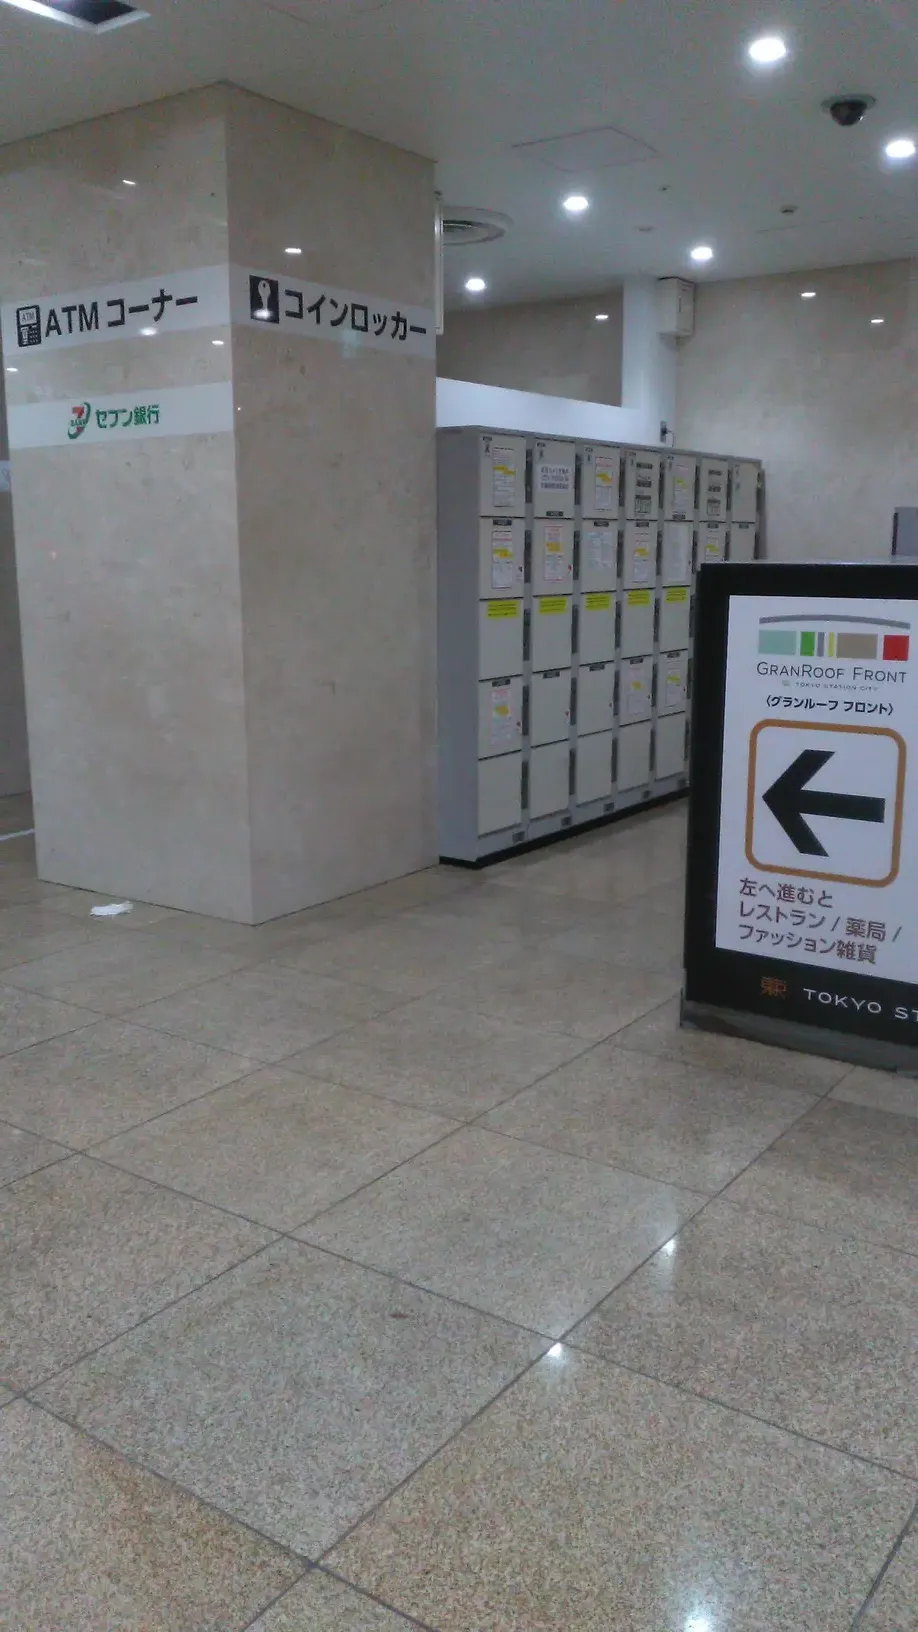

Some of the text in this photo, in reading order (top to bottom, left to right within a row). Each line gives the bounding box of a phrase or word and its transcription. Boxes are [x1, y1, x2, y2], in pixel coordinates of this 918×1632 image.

[45, 289, 198, 337] ATM コーナー
[284, 289, 426, 340] コインロッカー
[739, 877, 833, 908] 左へ進むと
[738, 924, 877, 964] ファッション雑貨
[803, 988, 882, 1014] TOKYO
